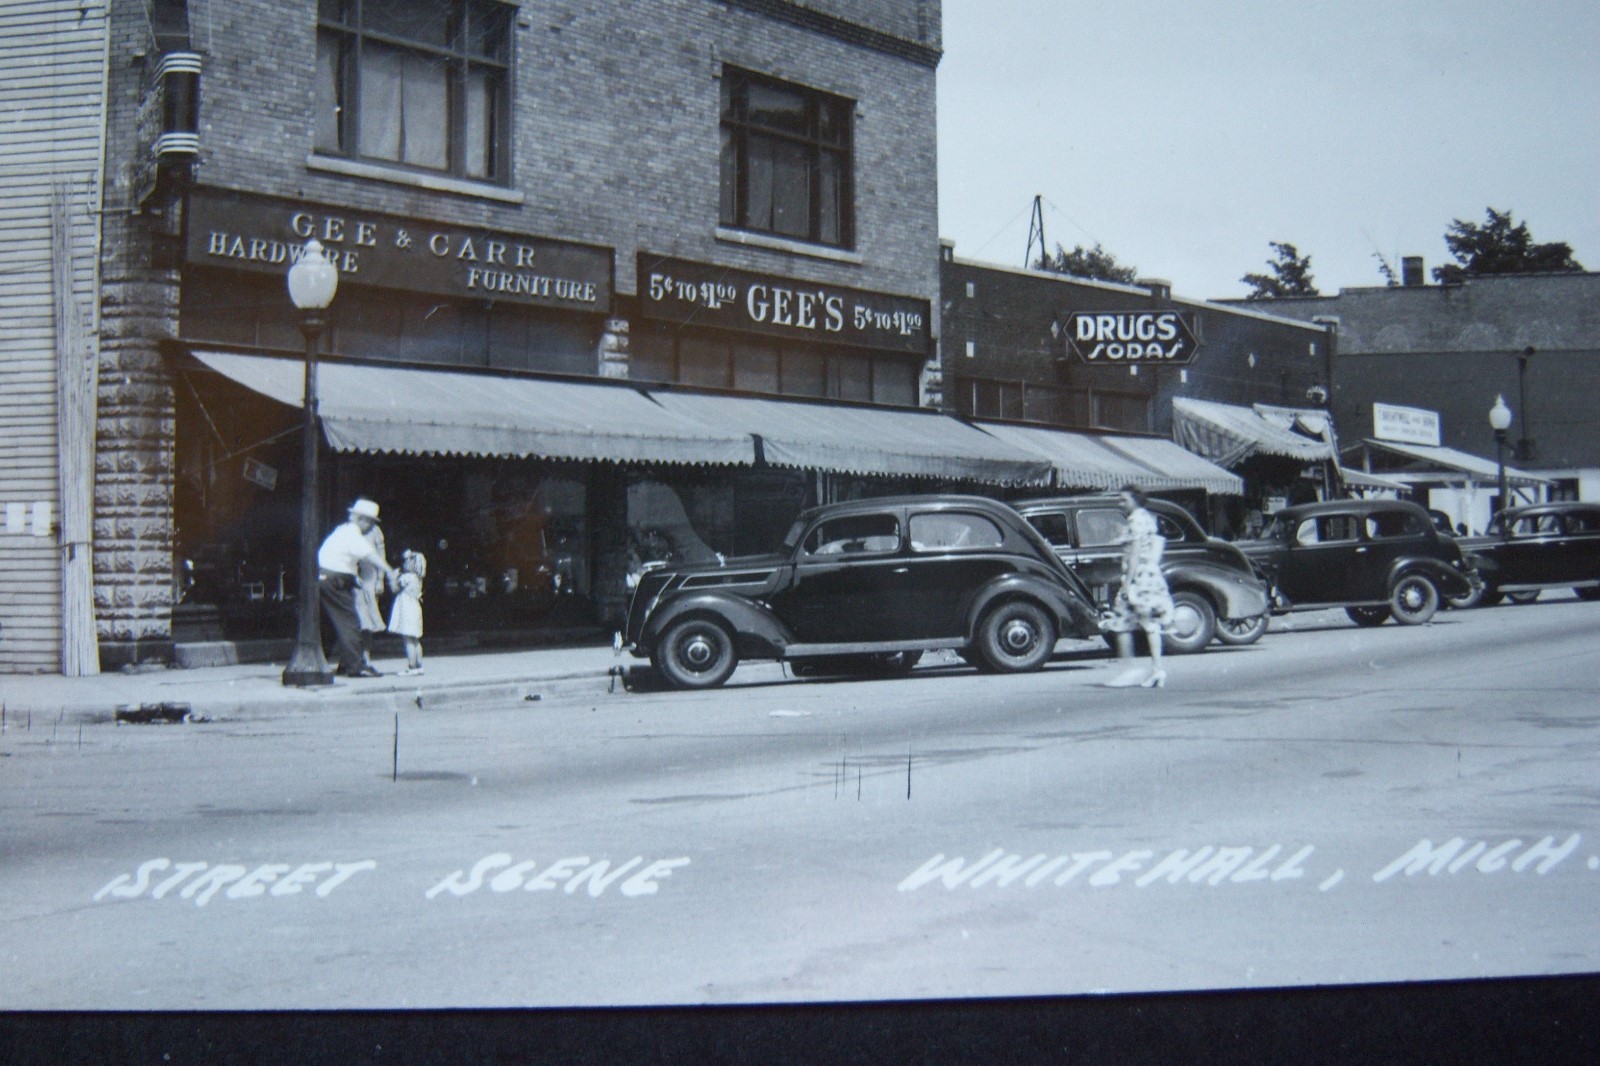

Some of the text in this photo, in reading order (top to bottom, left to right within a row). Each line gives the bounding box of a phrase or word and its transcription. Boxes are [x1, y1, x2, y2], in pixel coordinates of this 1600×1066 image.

[208, 231, 596, 302] HARDWRE FURNITURE
[292, 213, 535, 269] GEE & CARR
[650, 273, 672, 301] 5¢
[676, 282, 697, 302] TO
[747, 284, 844, 332] GEE'S
[854, 305, 873, 330] 5¢
[874, 312, 890, 330] TO
[1076, 314, 1176, 342] DRUGS
[1087, 342, 1184, 359] SODAS
